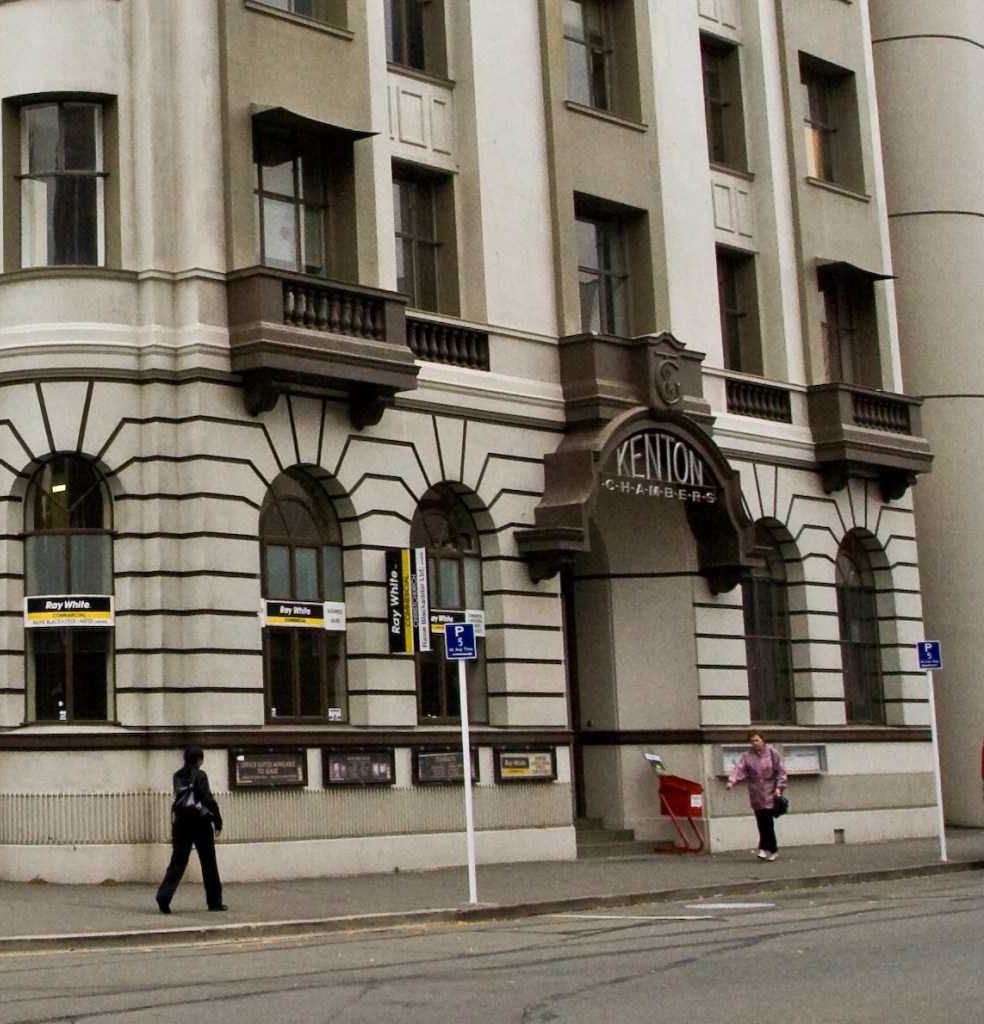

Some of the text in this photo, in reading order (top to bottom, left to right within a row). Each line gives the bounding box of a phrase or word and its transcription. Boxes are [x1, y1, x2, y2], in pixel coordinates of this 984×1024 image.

[616, 433, 704, 487] KENTON
[45, 600, 90, 611] Ray White
[389, 570, 402, 634] Ray White
[280, 605, 311, 615] Ray White
[455, 626, 465, 637] P
[457, 637, 464, 647] 5
[924, 643, 932, 652] P
